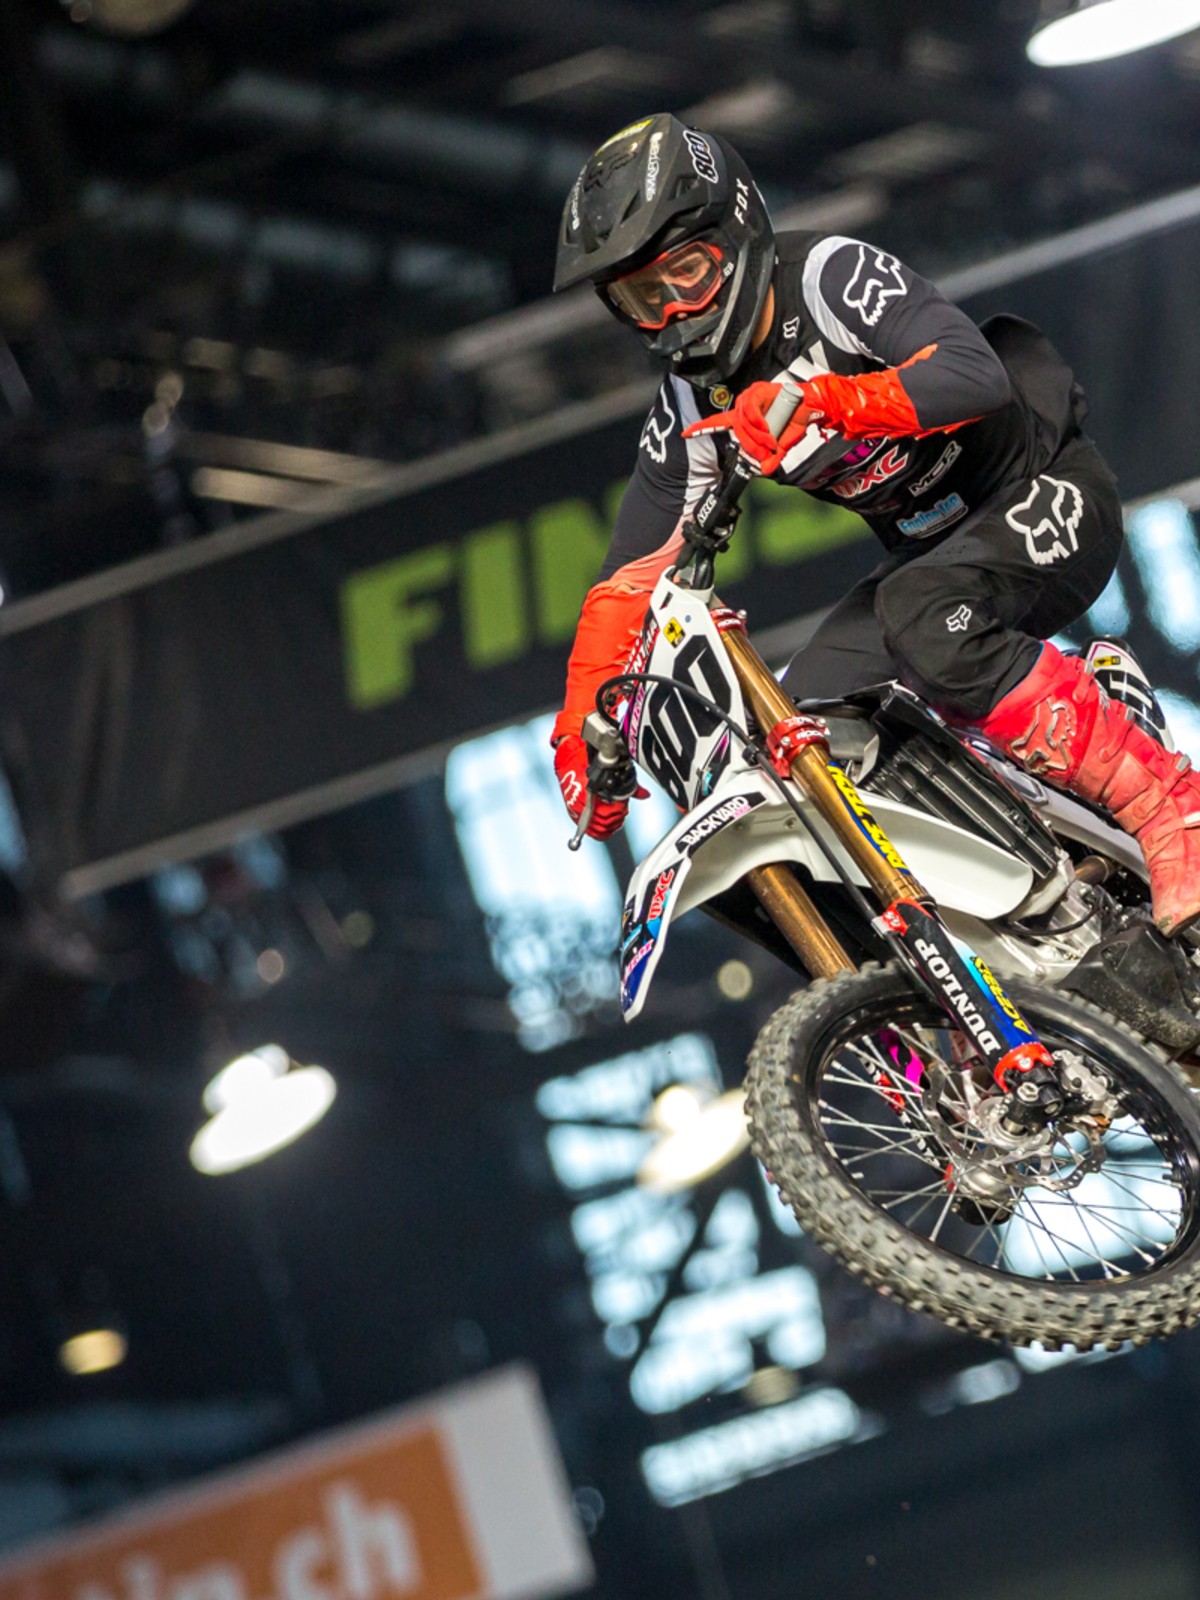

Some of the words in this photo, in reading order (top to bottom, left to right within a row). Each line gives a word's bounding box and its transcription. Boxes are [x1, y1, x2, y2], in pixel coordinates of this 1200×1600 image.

[734, 178, 749, 224] FOX
[641, 634, 732, 810] 800
[682, 796, 749, 847] BACKYARD
[914, 938, 1001, 1055] DUNLOP
